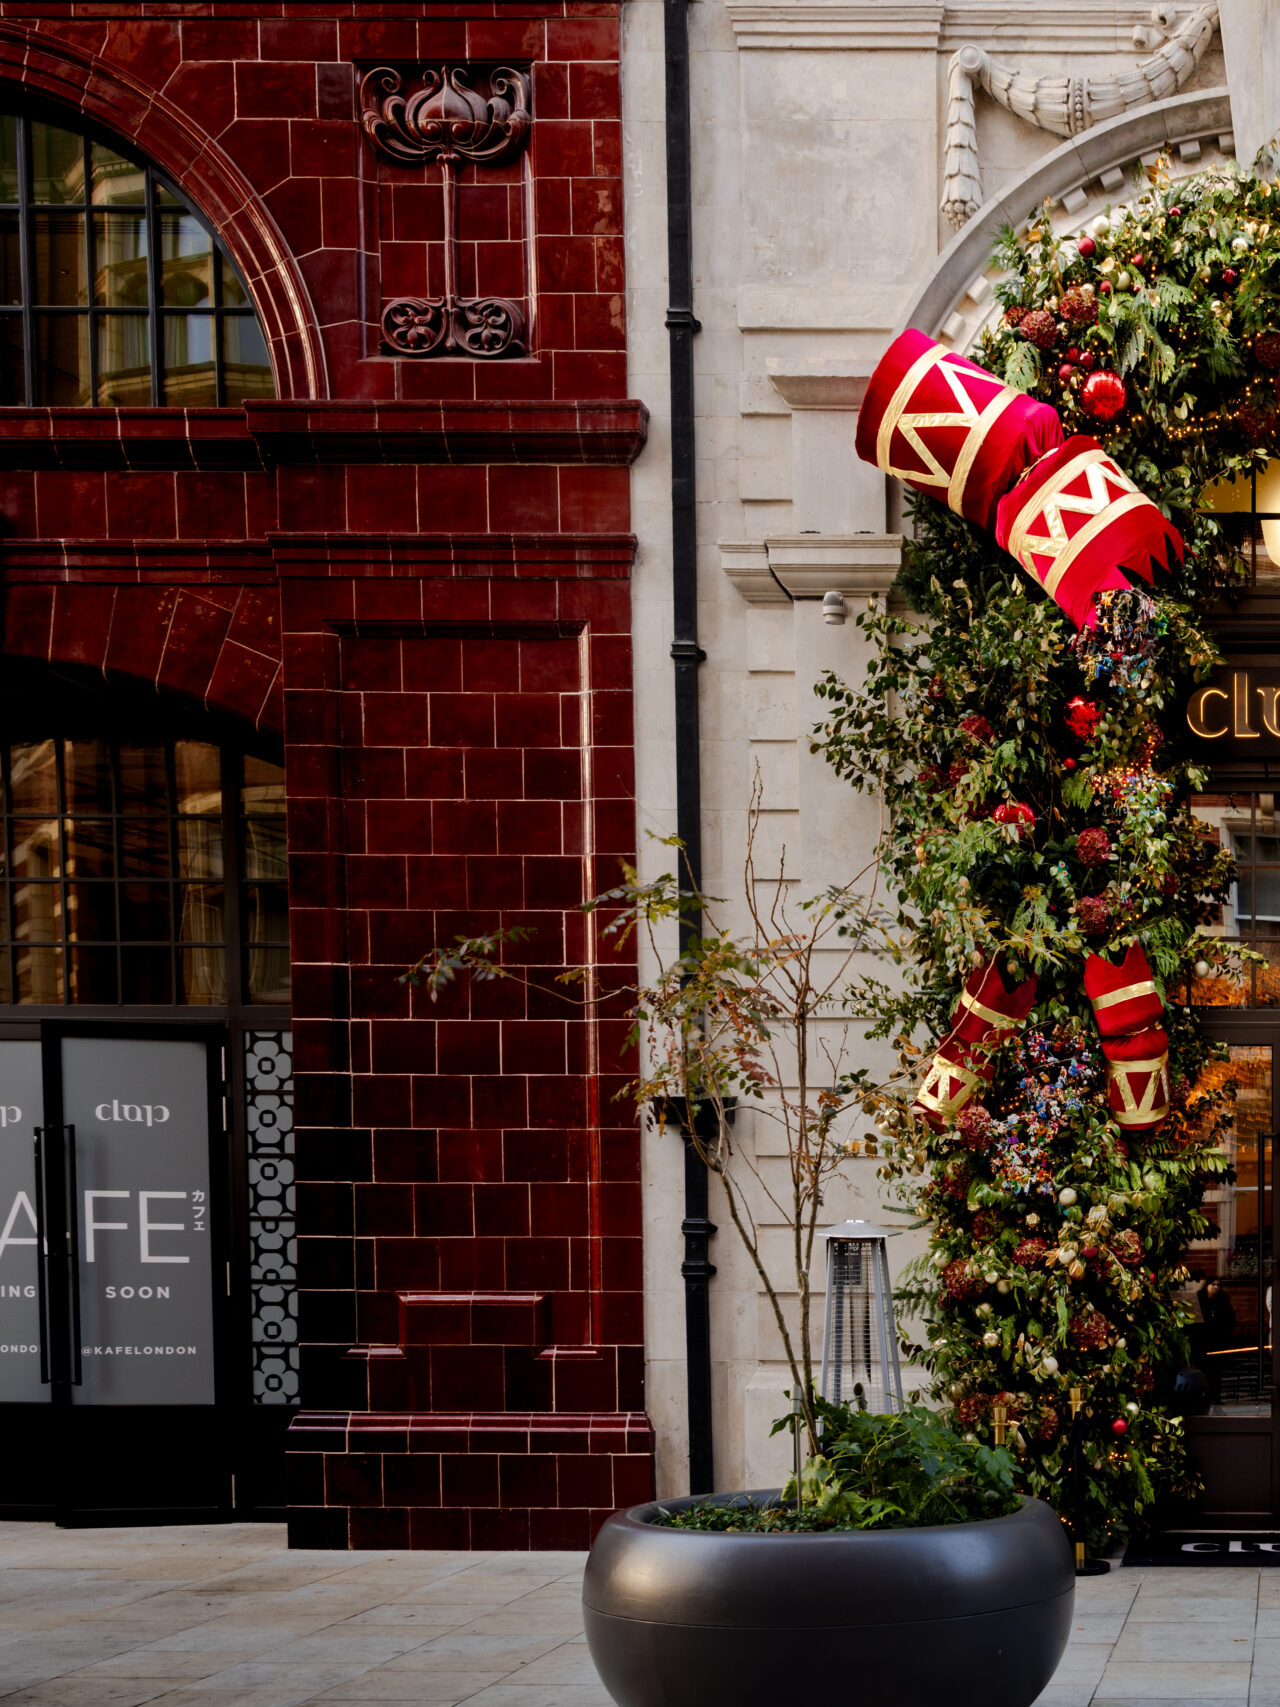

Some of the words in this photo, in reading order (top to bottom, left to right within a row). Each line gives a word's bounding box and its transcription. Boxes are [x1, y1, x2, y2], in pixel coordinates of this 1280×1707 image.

[95, 1099, 170, 1127] clap
[105, 1286, 170, 1299] SOON
[82, 1346, 197, 1356] @KAFELONDON
